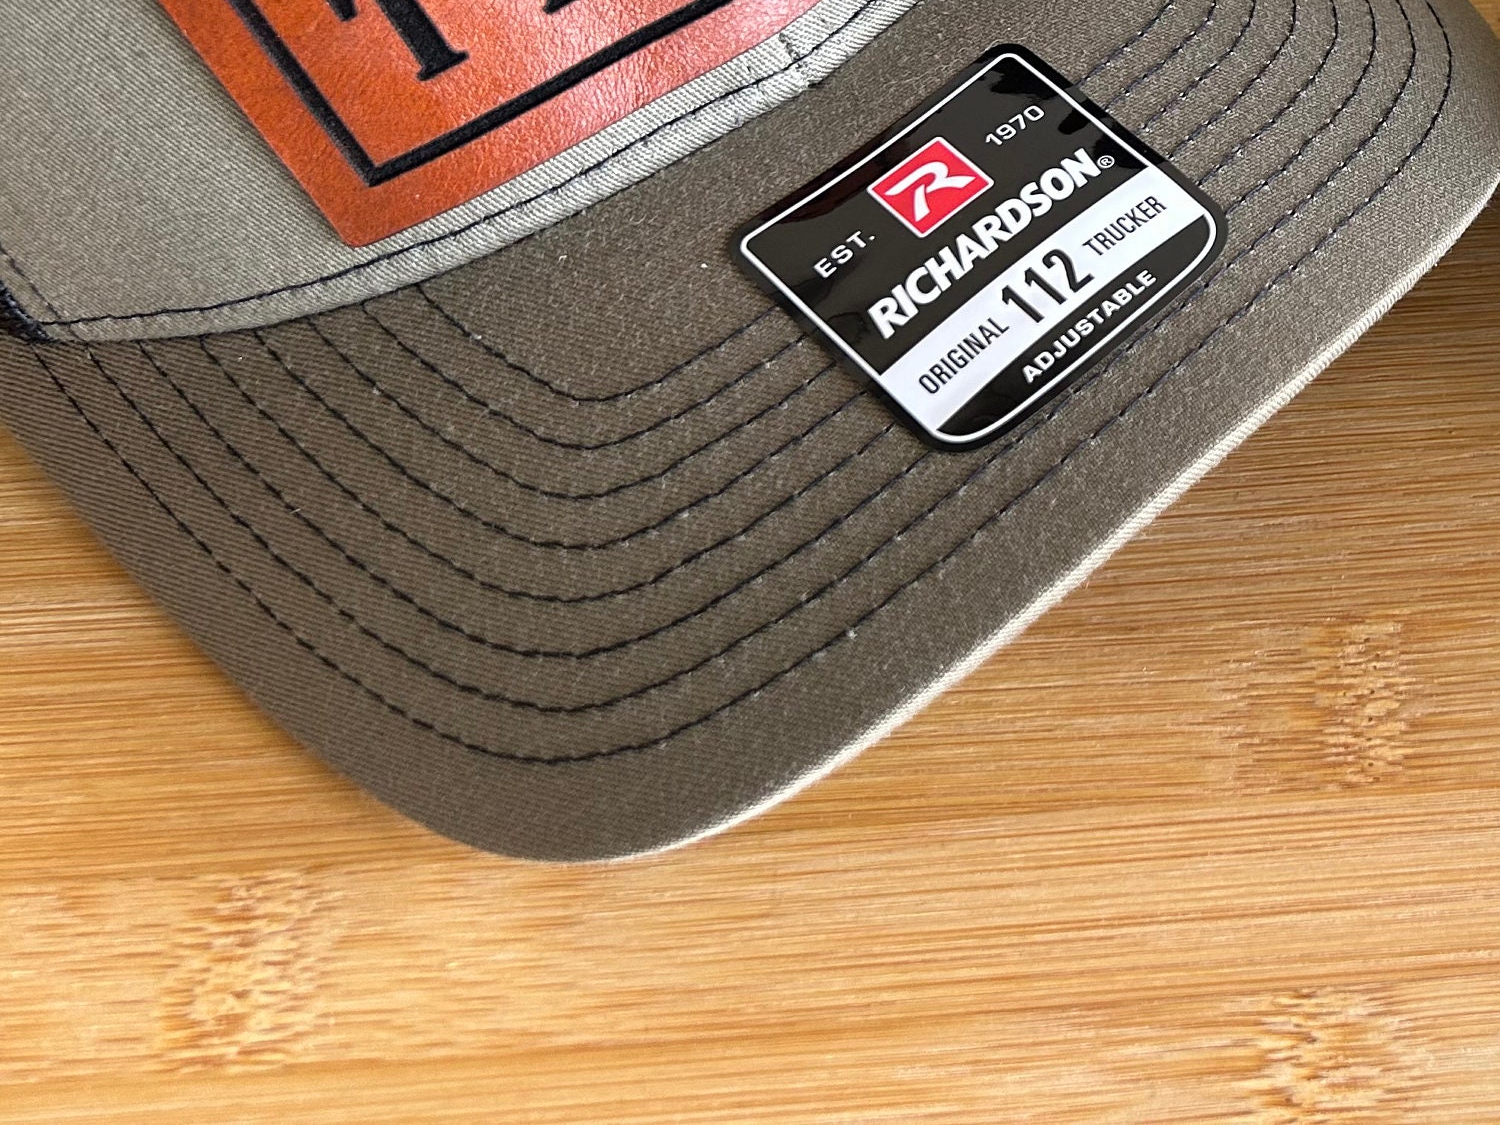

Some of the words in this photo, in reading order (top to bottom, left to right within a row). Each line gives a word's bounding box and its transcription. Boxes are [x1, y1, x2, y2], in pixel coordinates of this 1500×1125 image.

[813, 229, 876, 279] EST.
[985, 104, 1045, 147] 1970
[919, 316, 1010, 395] ORIGINAL
[1001, 248, 1095, 324] 112
[1082, 194, 1168, 257] TRUCKER
[1022, 269, 1157, 384] ADJUSTABLE
